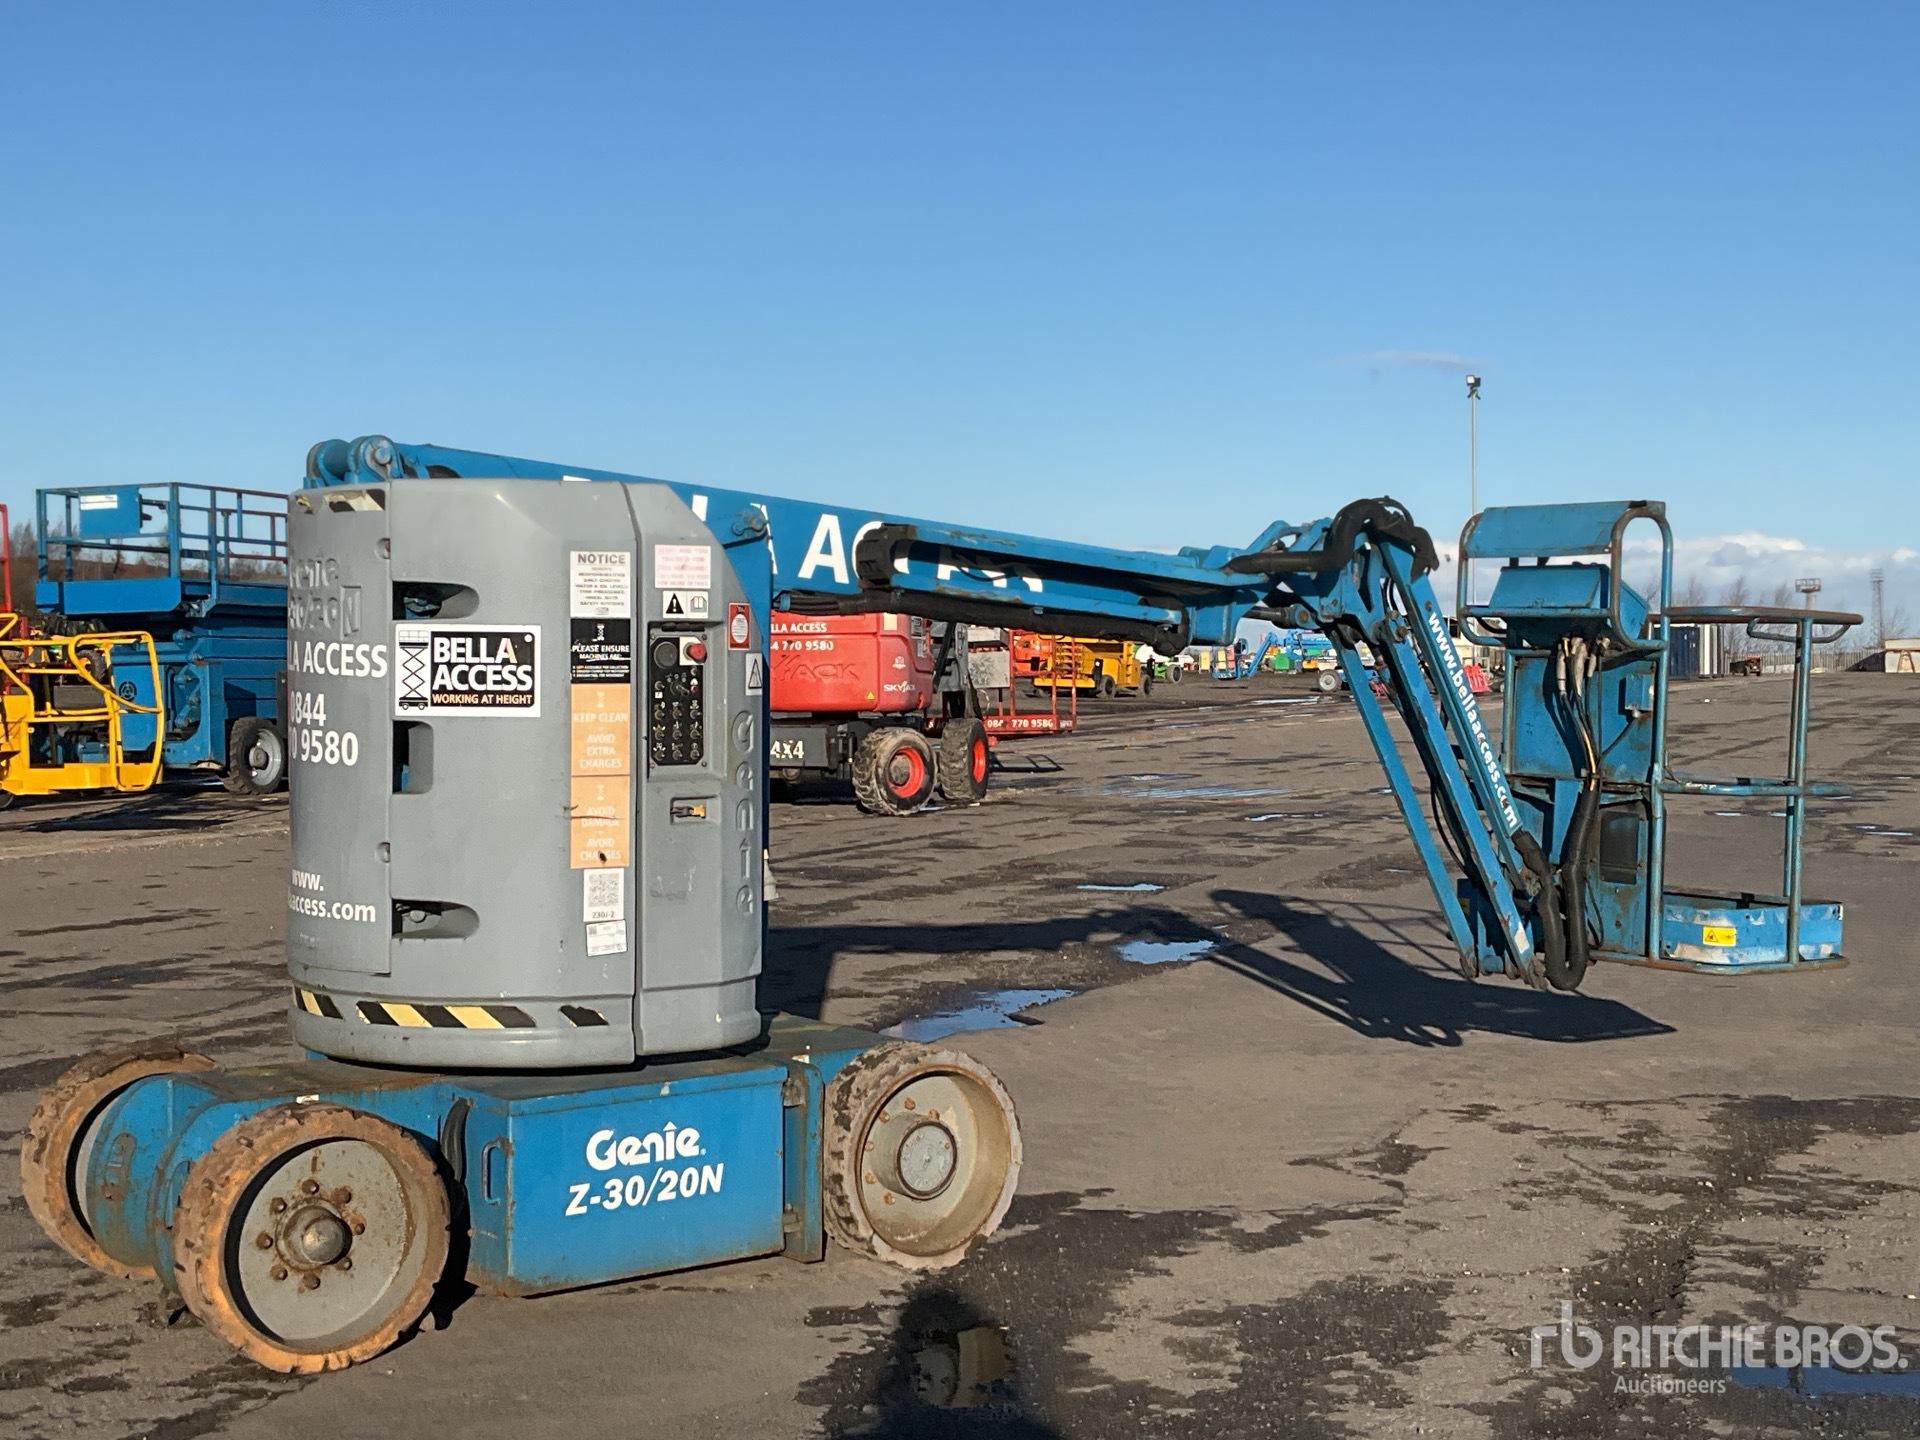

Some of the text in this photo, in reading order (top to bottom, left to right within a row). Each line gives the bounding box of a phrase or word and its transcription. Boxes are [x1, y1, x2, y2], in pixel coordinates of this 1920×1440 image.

[577, 553, 627, 565] NOTICE
[790, 622, 827, 633] ACCESS
[433, 636, 518, 664] BELLA
[571, 644, 630, 653] PLEASE ENSURE
[782, 640, 803, 651] 770
[805, 640, 834, 651] 9580
[303, 641, 388, 678] ACCESS
[432, 664, 533, 692] ACCESS
[432, 693, 533, 705] WORKING AT HEIGHT
[290, 690, 327, 727] 0844
[573, 711, 629, 723] KEEP CLEAN
[1428, 612, 1519, 829] www.bellaaccess.com
[586, 733, 616, 744] AVOID
[301, 728, 359, 767] 9580
[586, 746, 616, 757] EXTRA
[579, 758, 623, 769] CHARGES
[586, 805, 616, 816] AVOID
[586, 837, 616, 848] AVOID
[586, 1121, 701, 1171] Genie
[565, 1163, 725, 1217] Z-30/20N
